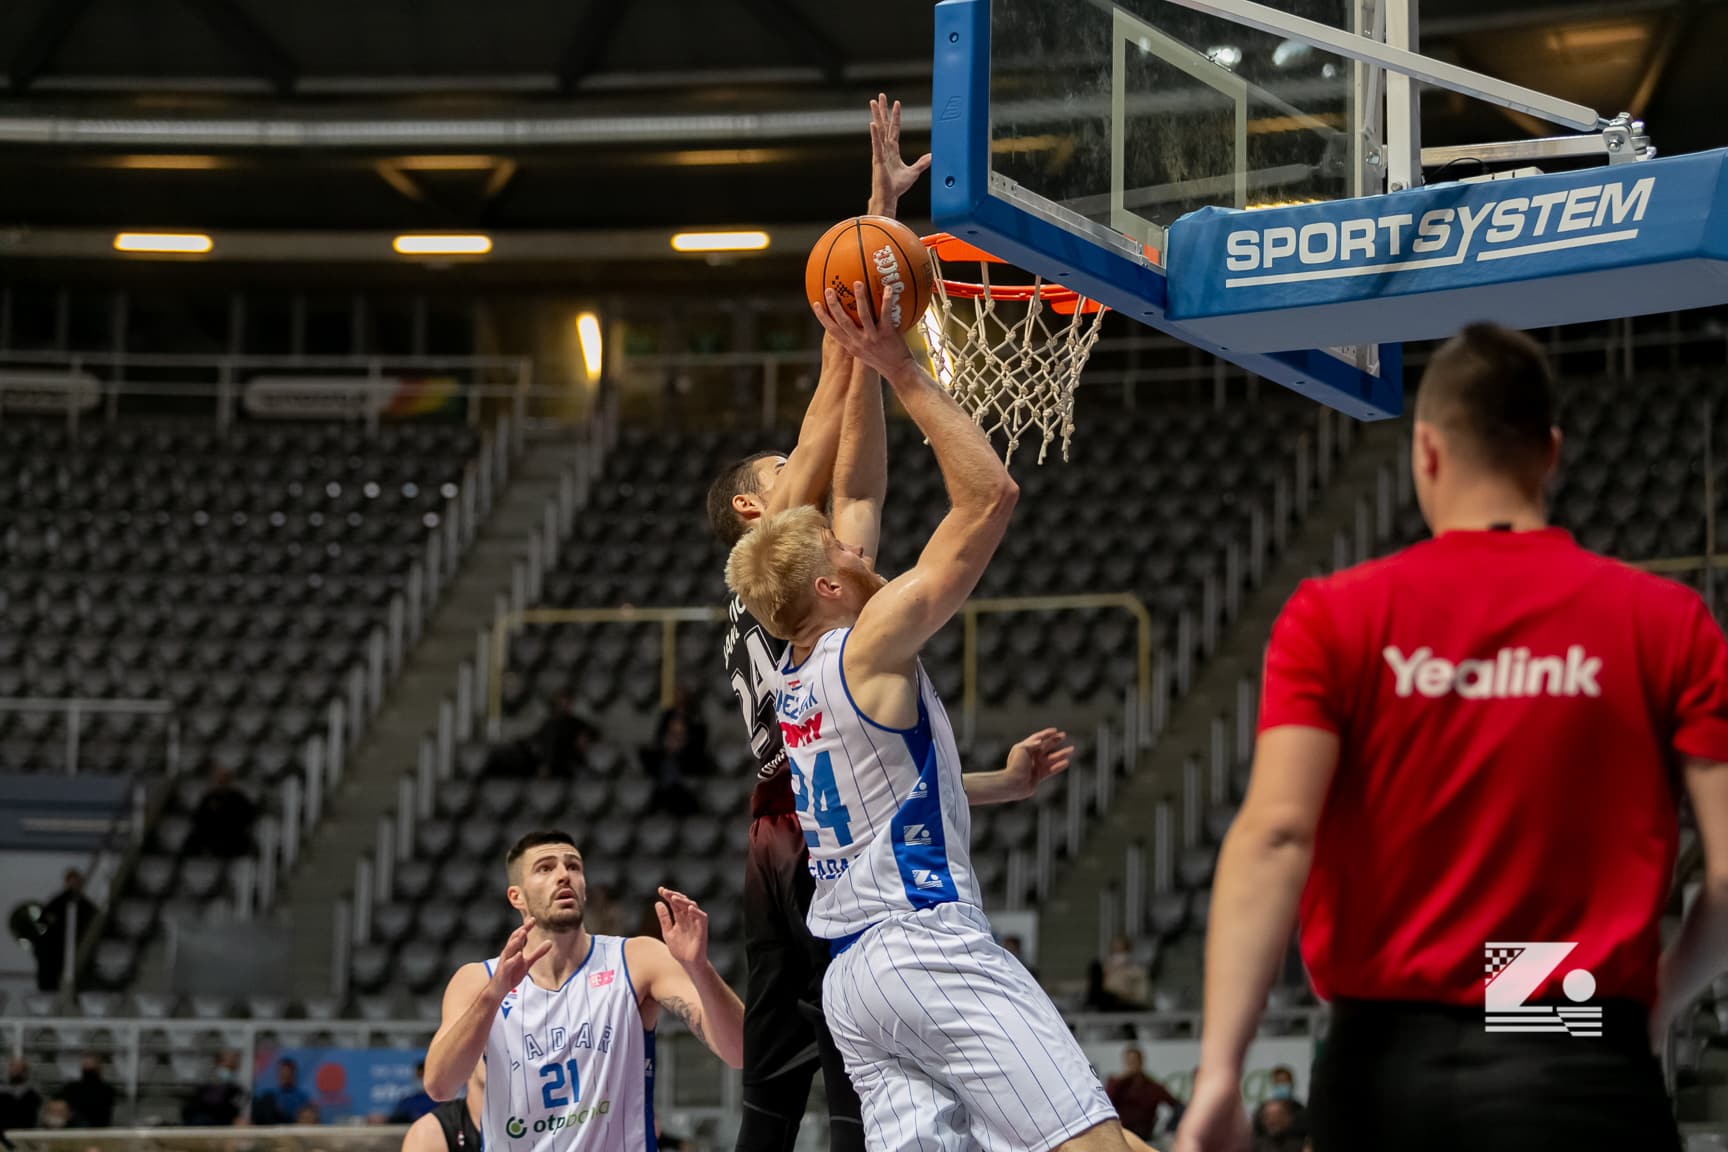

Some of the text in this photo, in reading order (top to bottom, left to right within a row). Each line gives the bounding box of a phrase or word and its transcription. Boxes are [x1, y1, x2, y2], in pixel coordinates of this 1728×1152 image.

[1382, 644, 1603, 698] Yealink
[788, 750, 854, 848] 24
[511, 1022, 613, 1072] ADAR
[539, 1058, 580, 1109] 21
